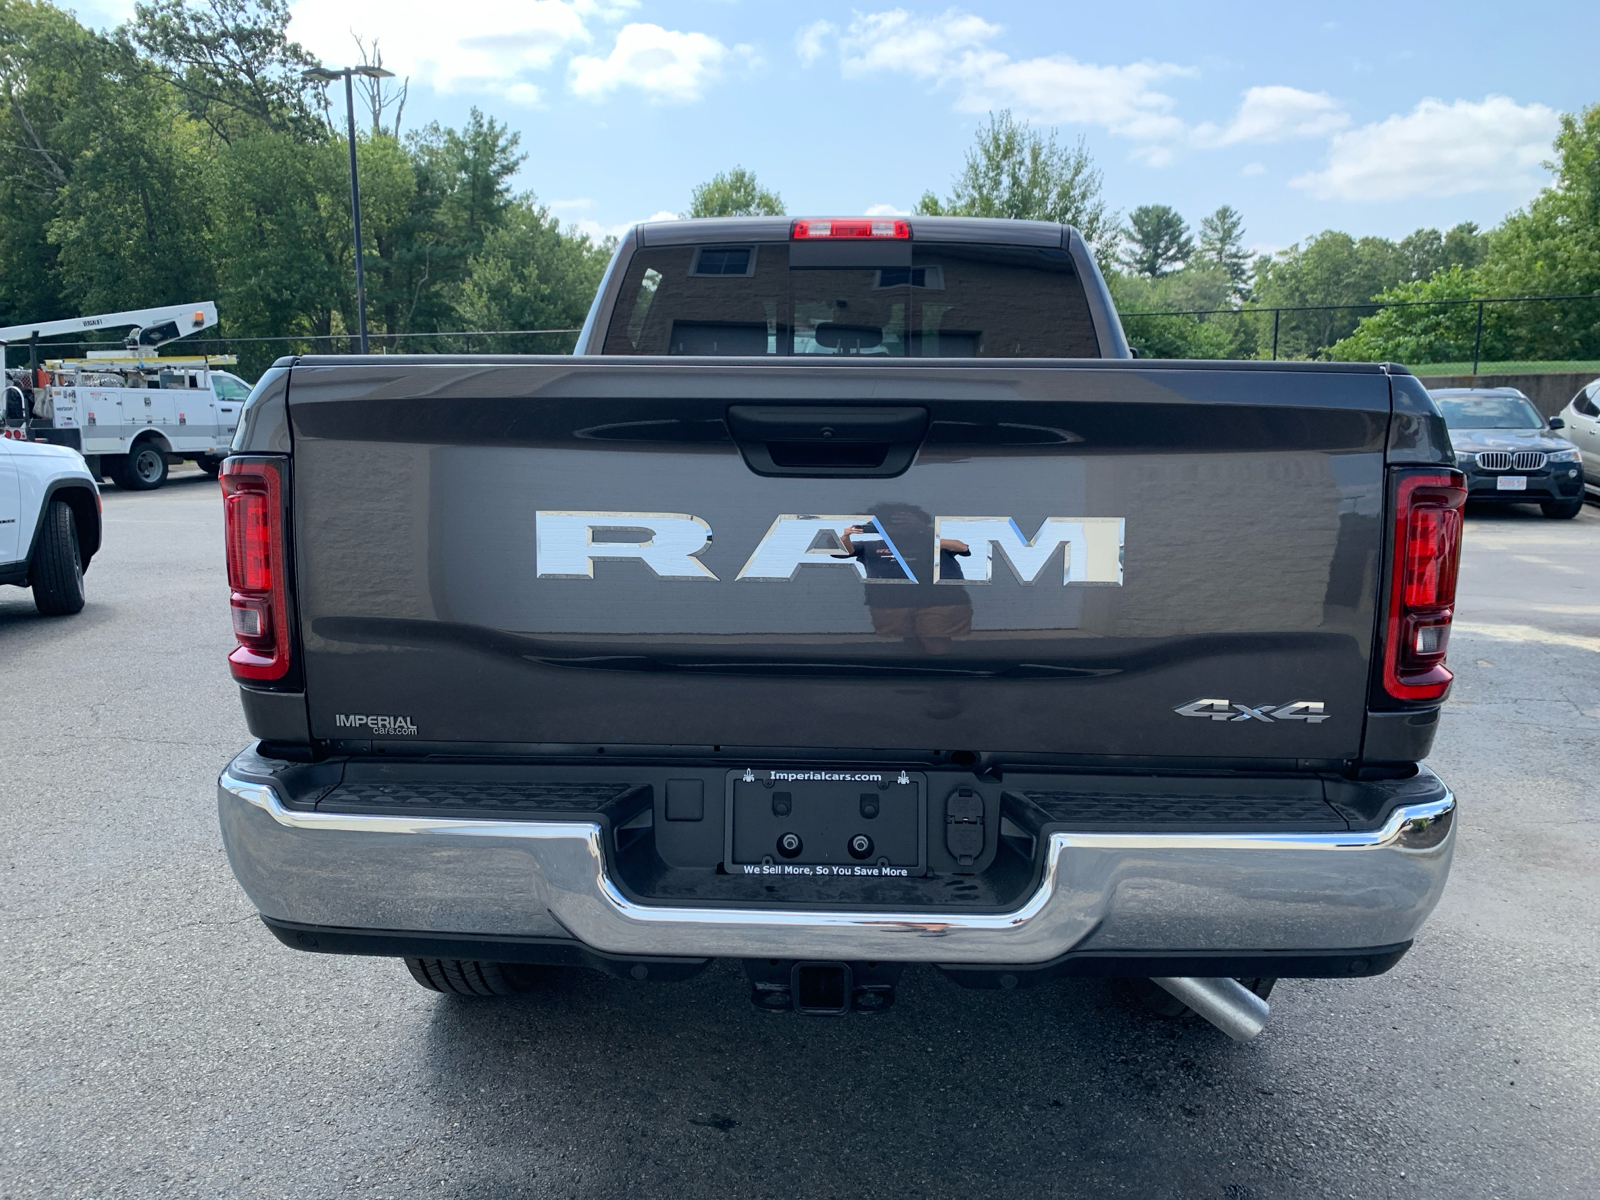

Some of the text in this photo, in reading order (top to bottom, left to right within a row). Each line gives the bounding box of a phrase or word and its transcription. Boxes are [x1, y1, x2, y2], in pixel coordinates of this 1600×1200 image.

[535, 510, 1126, 587] RAM
[335, 714, 418, 729] IMPERIAL
[372, 726, 418, 736] cars.com
[770, 770, 882, 782] Imperialcars.com
[743, 865, 908, 877] We Sell More, So You Save More
